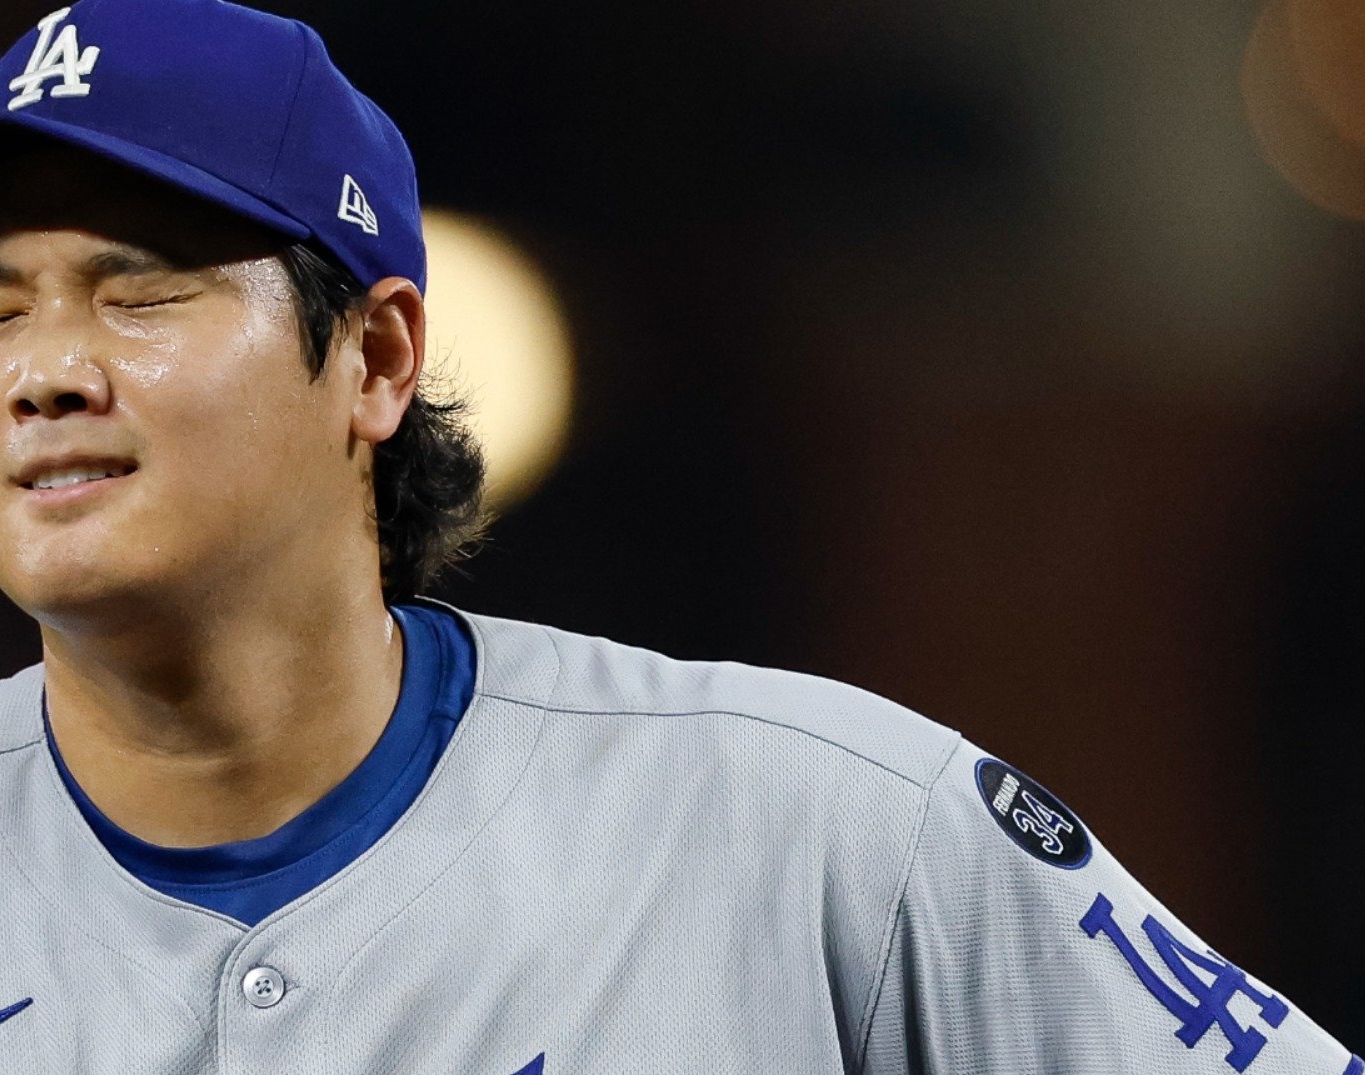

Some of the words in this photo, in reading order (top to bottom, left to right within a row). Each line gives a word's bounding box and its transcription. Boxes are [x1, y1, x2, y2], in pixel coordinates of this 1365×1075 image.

[8, 5, 100, 112] LA
[1012, 789, 1073, 855] 34
[1079, 893, 1289, 1073] LA
